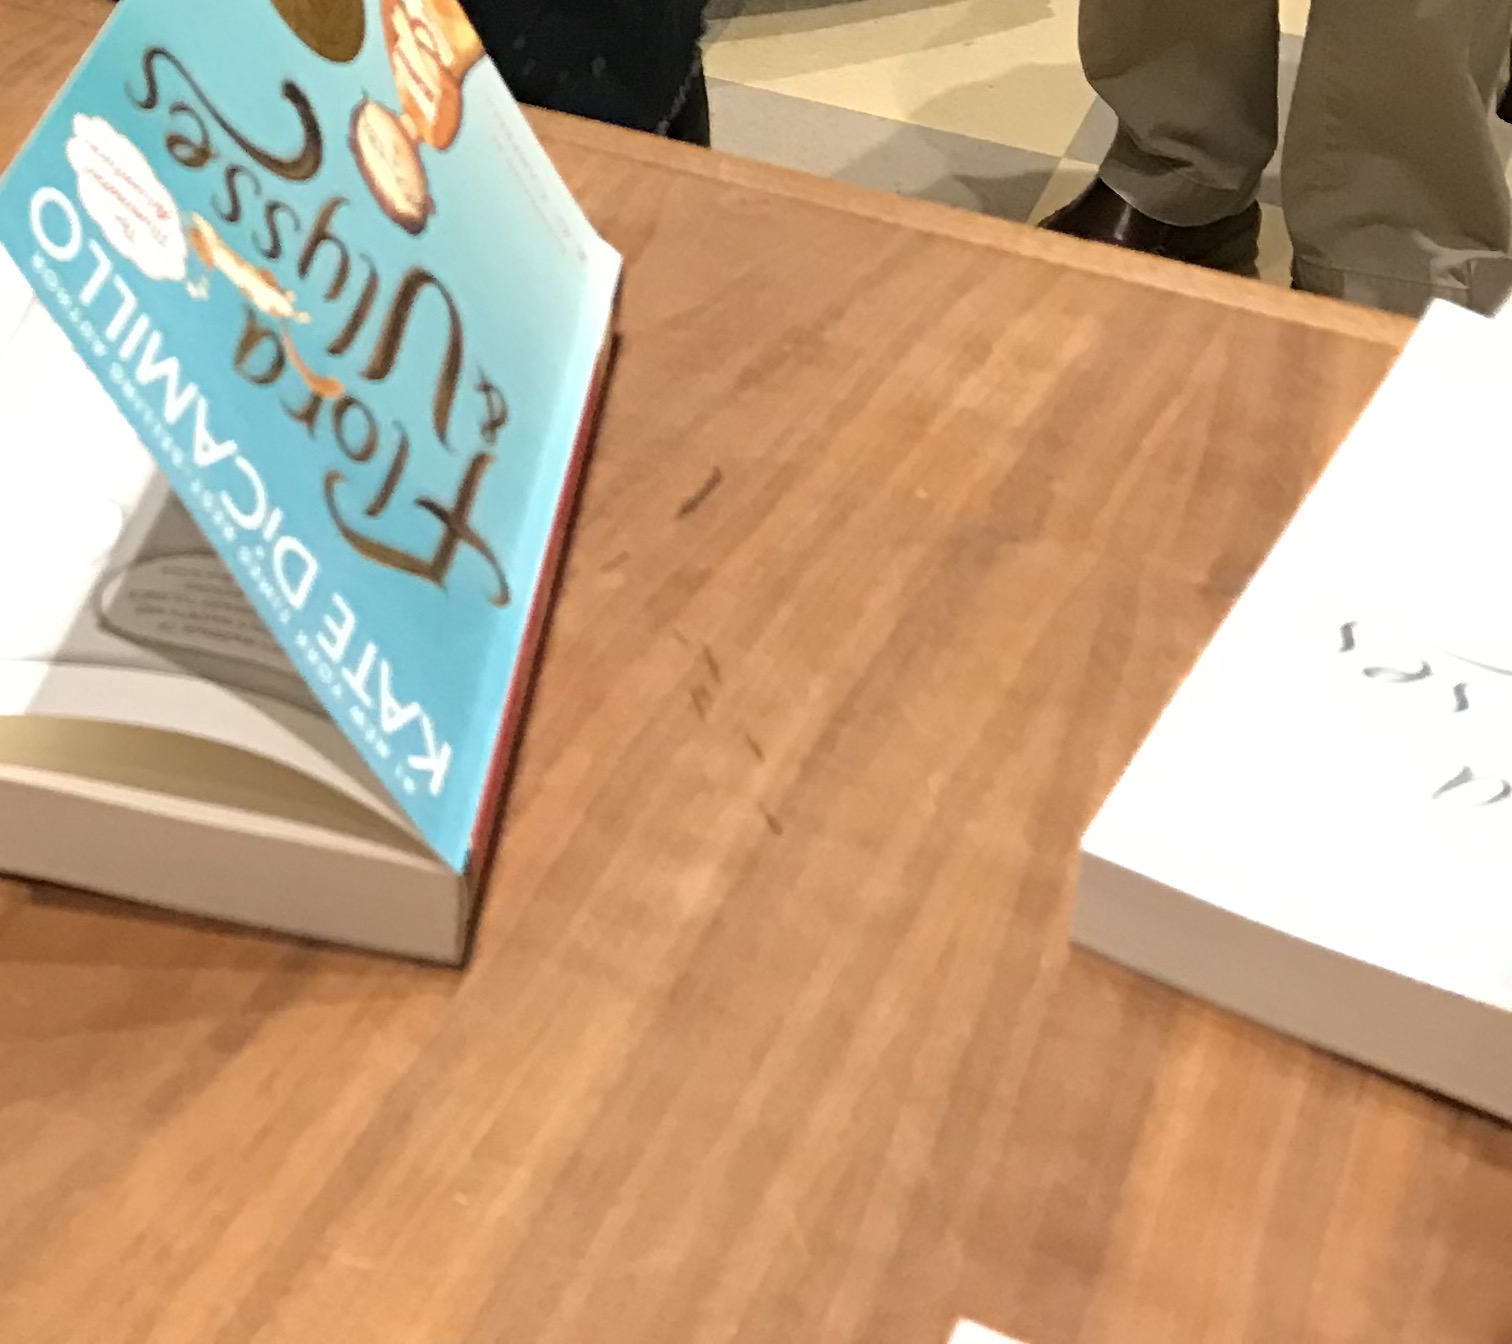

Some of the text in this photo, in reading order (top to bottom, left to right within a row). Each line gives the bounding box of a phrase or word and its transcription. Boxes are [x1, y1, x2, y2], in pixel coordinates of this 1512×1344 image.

[124, 46, 466, 453] Ulysses
[233, 304, 509, 607] Flora
[294, 627, 343, 700] YORK
[316, 592, 452, 796] KATE
[349, 703, 390, 760] NEW
